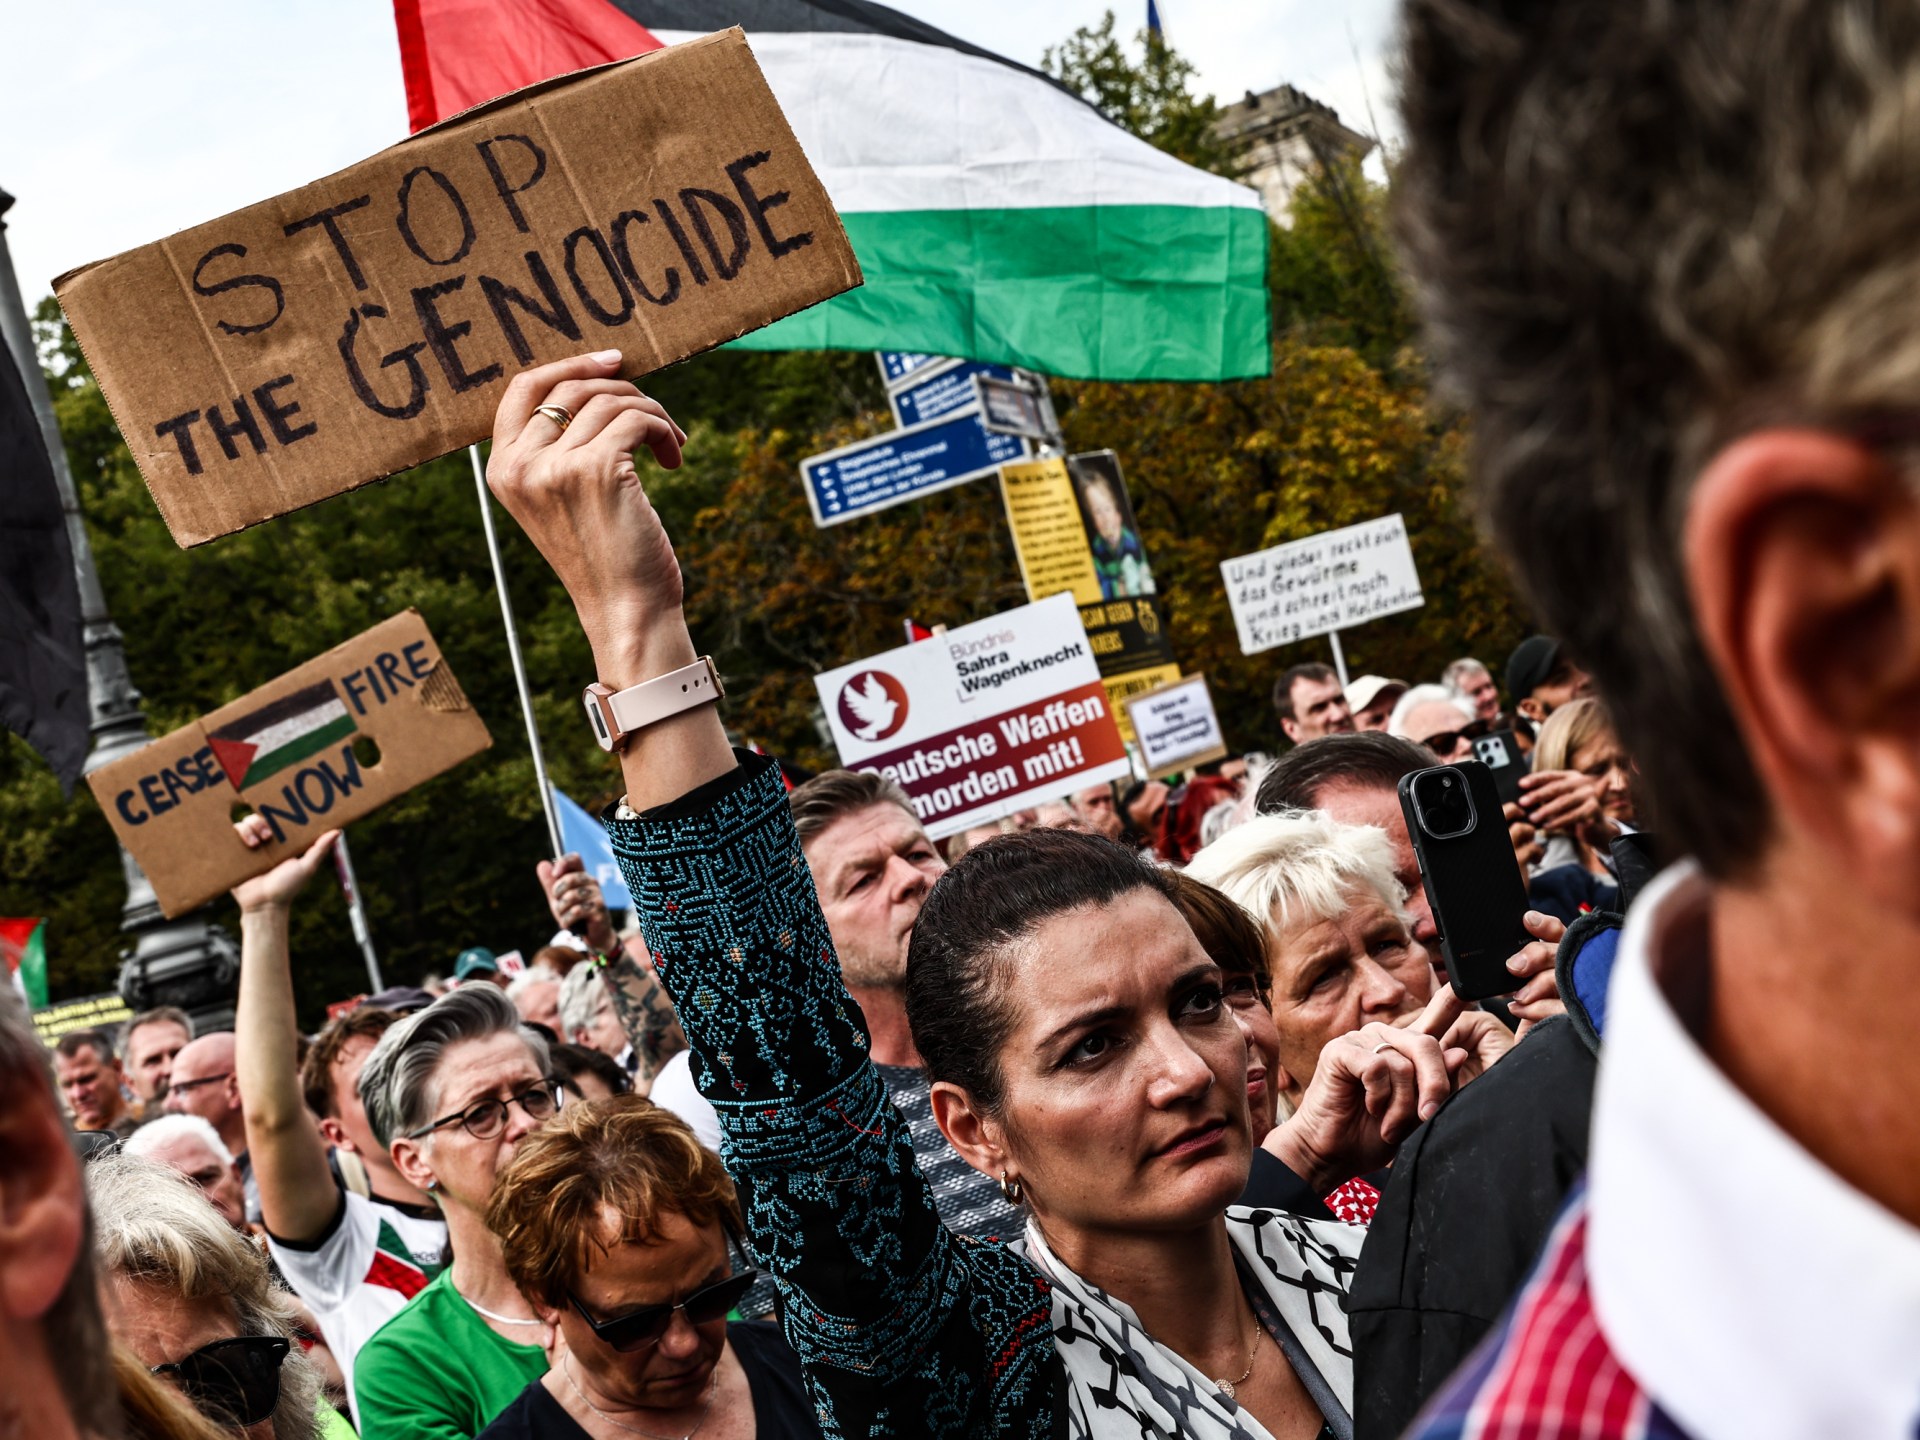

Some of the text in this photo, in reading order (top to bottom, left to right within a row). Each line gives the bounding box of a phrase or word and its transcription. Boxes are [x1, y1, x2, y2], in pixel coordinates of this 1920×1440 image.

[192, 133, 547, 337] STOP
[155, 149, 815, 475] THE GENOCIDE
[1231, 560, 1266, 584] Und
[1270, 559, 1359, 595] Gewürme
[949, 629, 1015, 661] Bündnis
[1251, 622, 1302, 646] Krieg
[956, 650, 1009, 677] Sahra
[961, 642, 1083, 694] Wagenknecht
[115, 640, 434, 826] CEASE FIRE
[998, 695, 1105, 748] Waffen
[258, 746, 363, 844] NOW
[909, 735, 1085, 819] morden mit!
